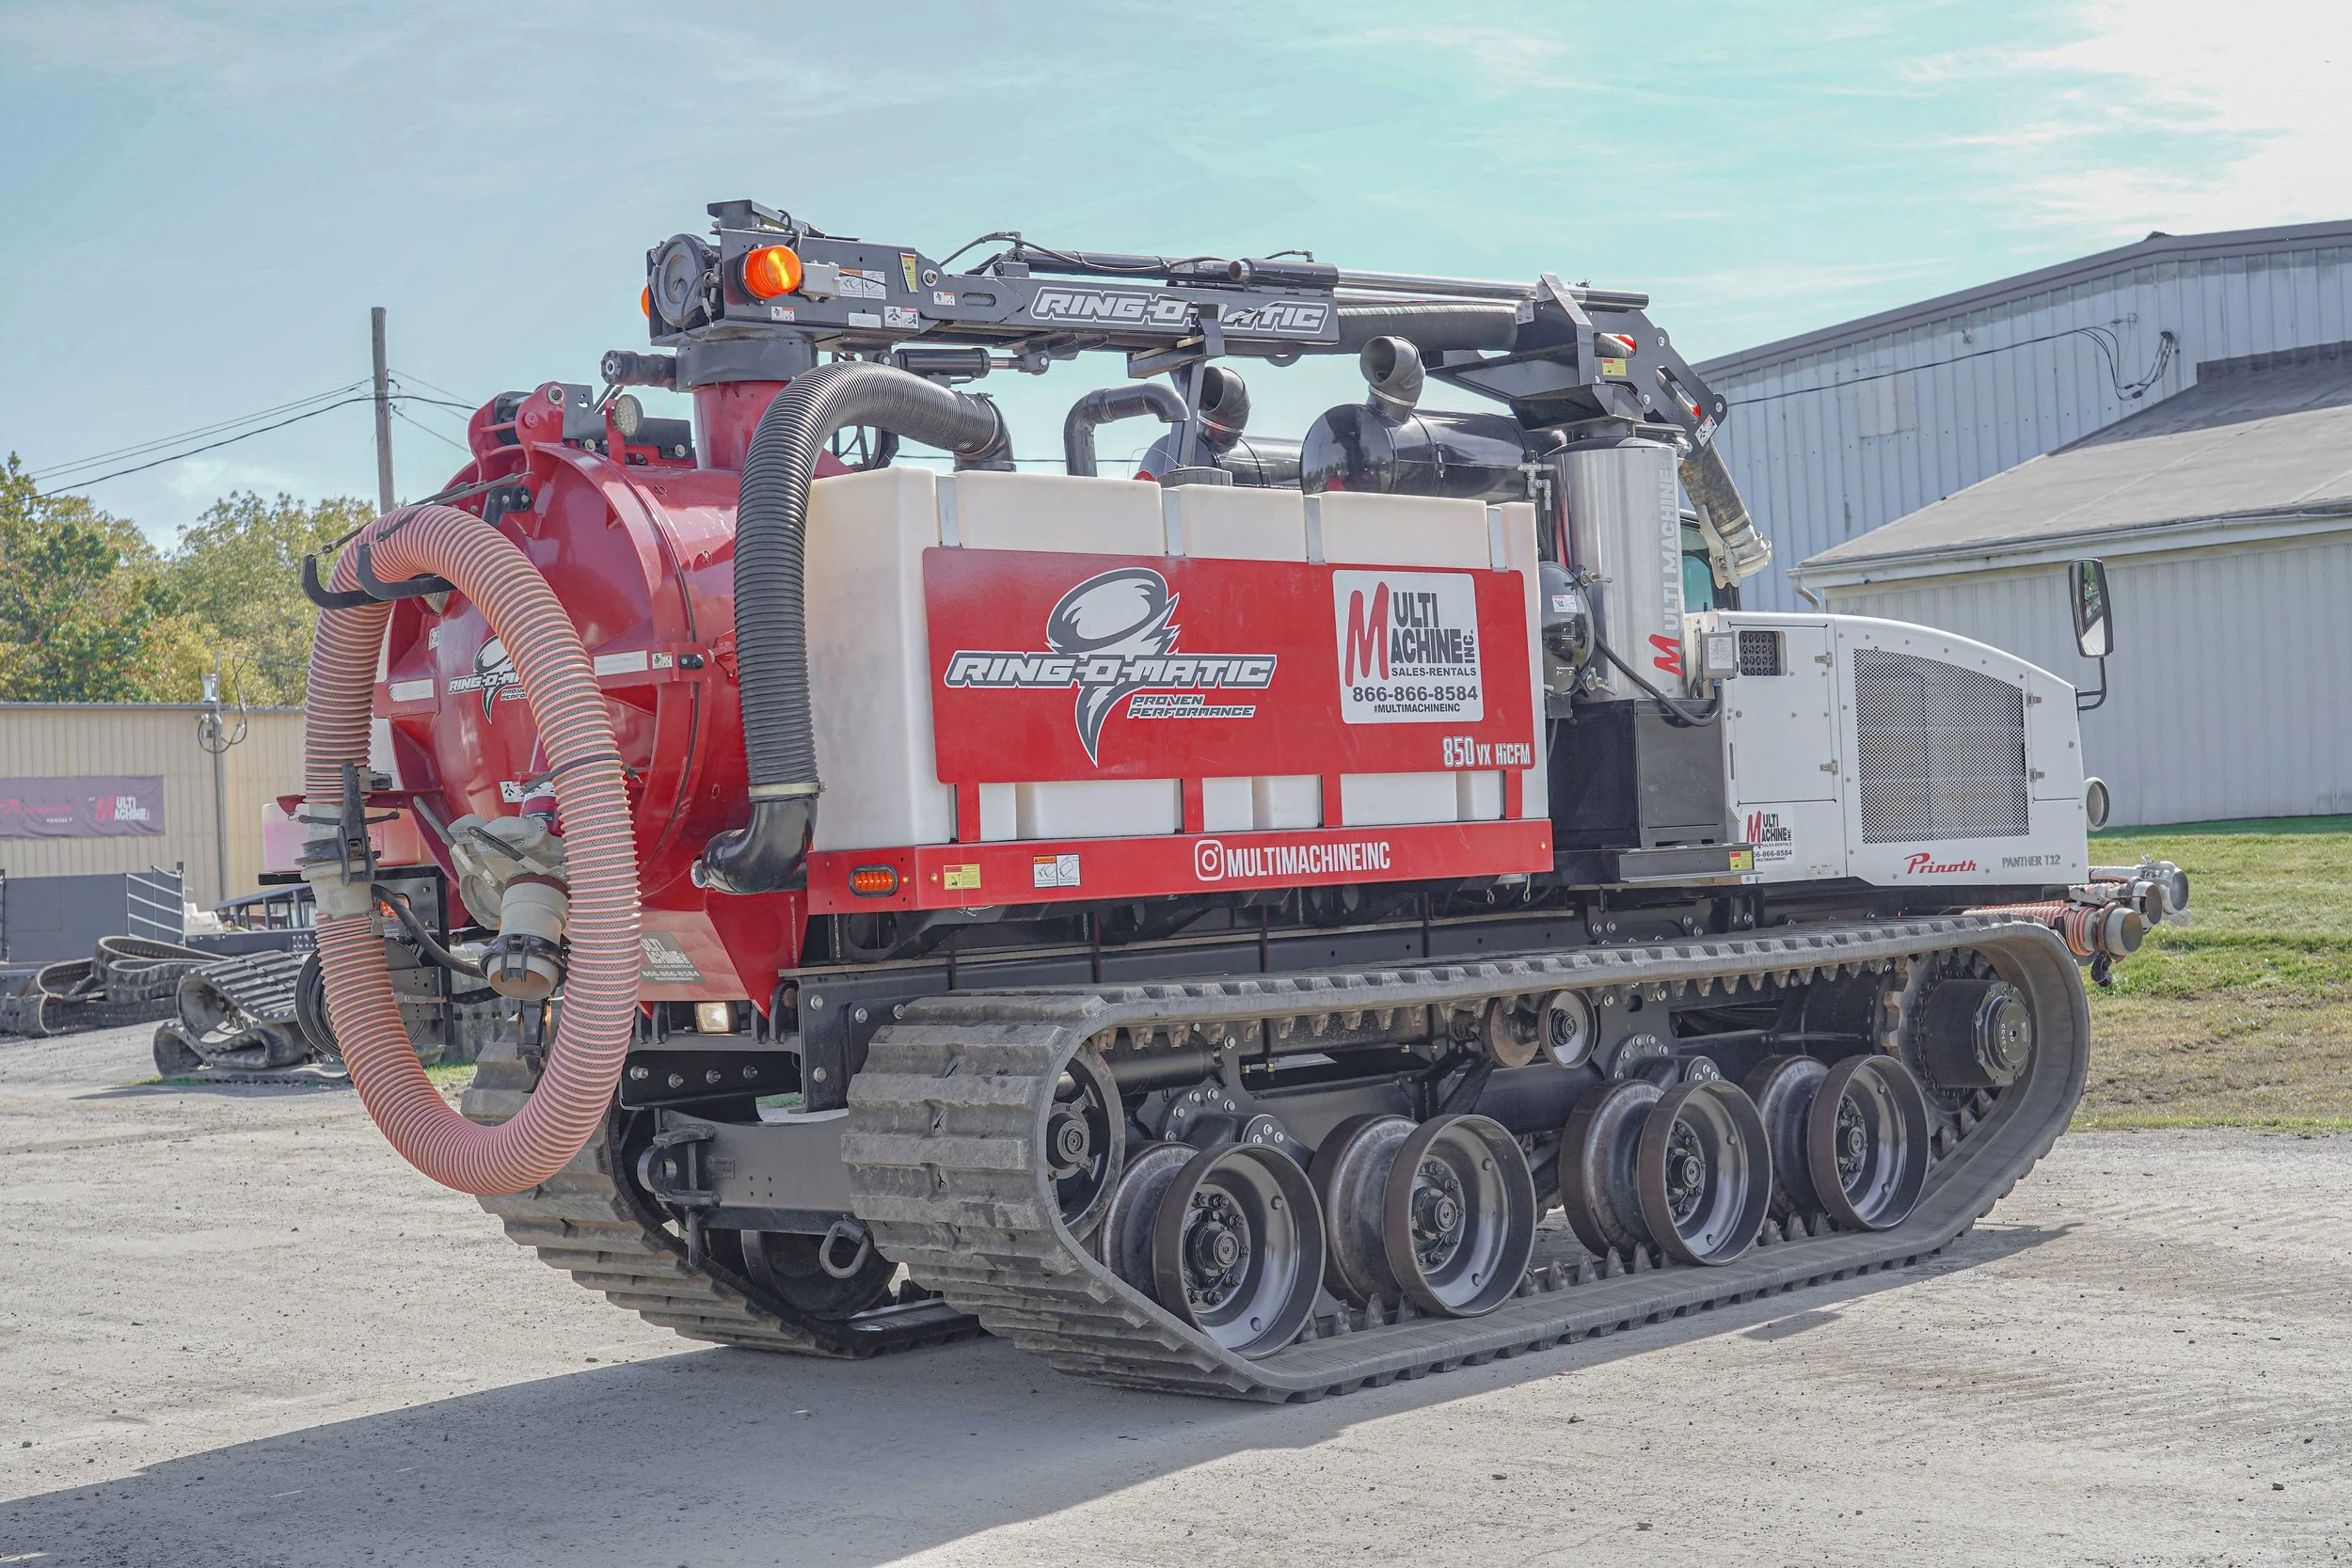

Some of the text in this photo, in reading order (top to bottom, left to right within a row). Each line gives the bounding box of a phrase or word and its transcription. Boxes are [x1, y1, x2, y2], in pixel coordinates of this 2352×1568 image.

[1033, 292, 1326, 328] RING-O-ATIC
[1659, 468, 1677, 575] MACHINE
[946, 653, 1275, 687] RING-O-MATIC
[1391, 667, 1477, 677] SALES-RENTALS
[1131, 693, 1205, 705] PROVEN
[1352, 686, 1479, 703] 866-866-8584
[1128, 706, 1255, 719] PERFORMANCE
[1442, 736, 1532, 768] 850 VX HiCFM
[1227, 842, 1391, 878] MULTIMACHINEINC
[1903, 852, 2061, 875] Prinoth PANTHER T12
